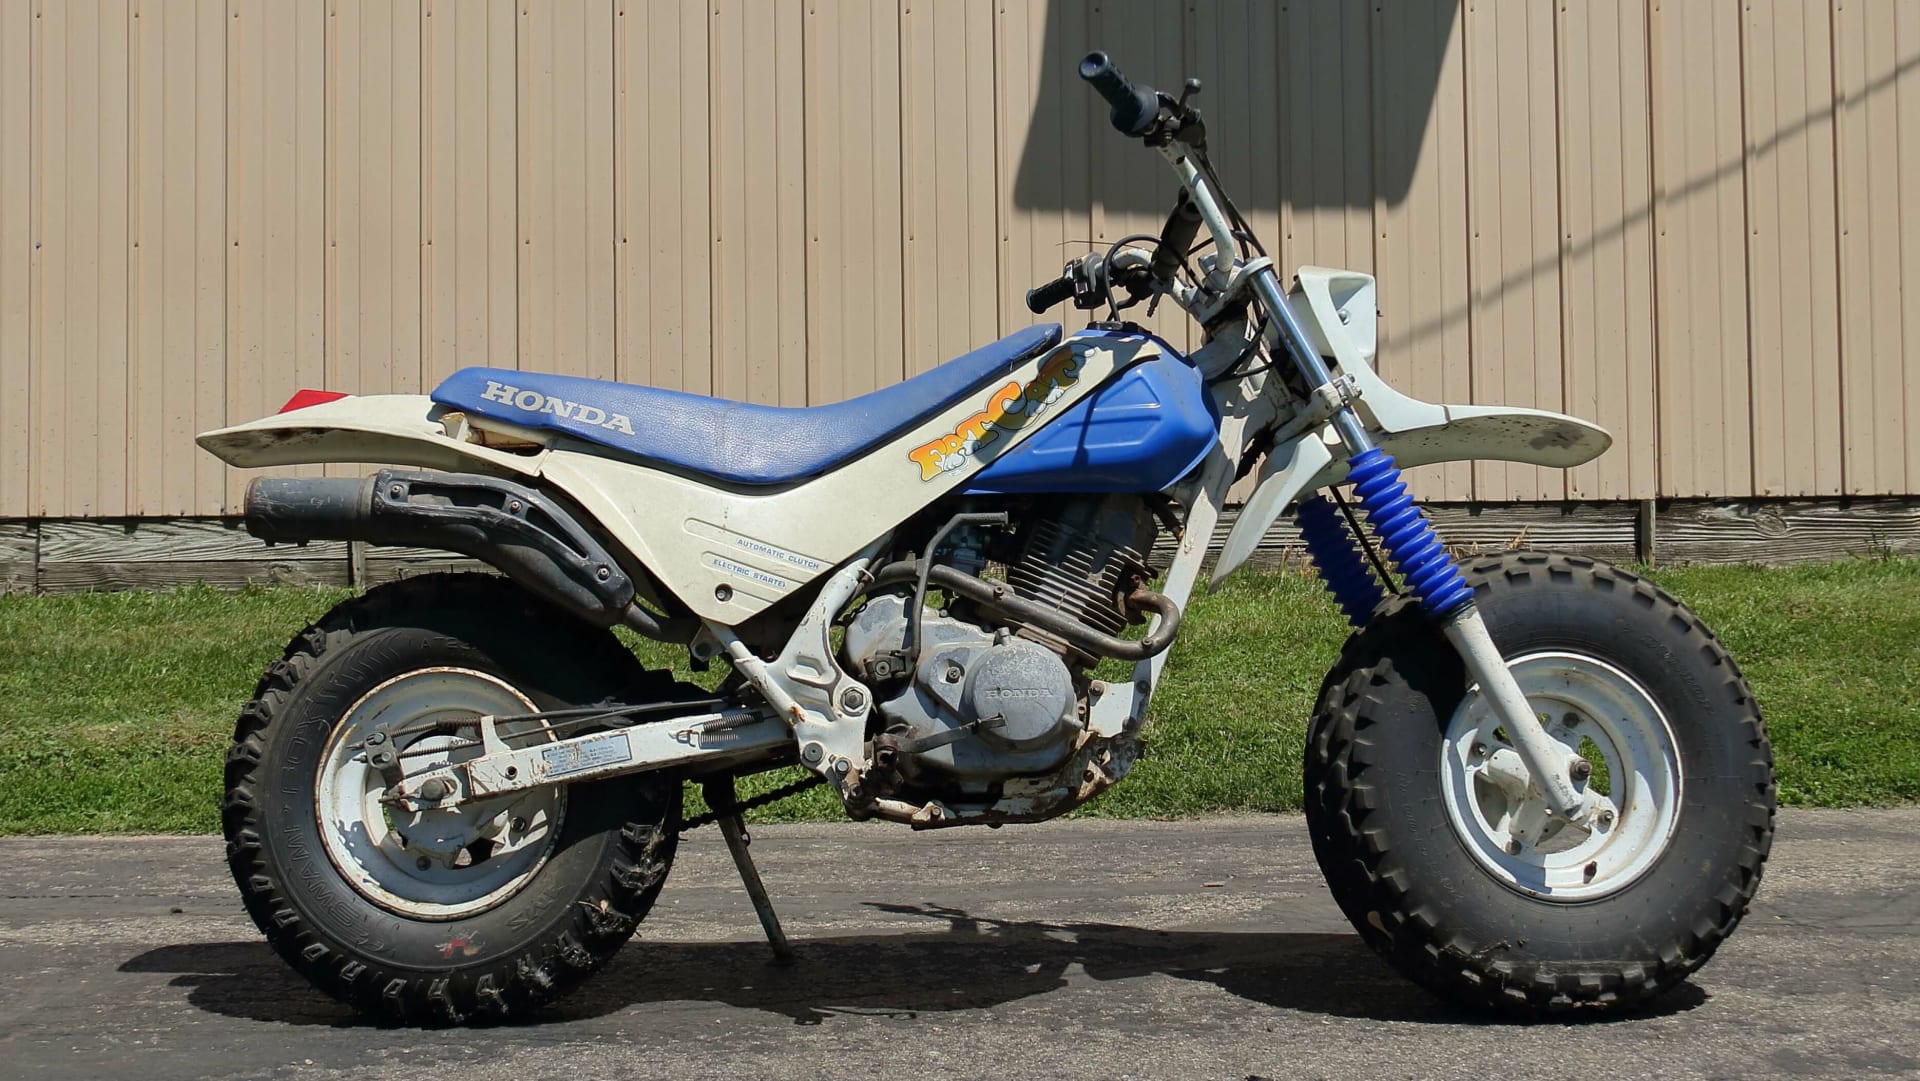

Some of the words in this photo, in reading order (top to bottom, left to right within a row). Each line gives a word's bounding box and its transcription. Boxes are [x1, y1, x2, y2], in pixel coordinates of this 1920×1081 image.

[480, 381, 636, 436] HONDA
[737, 539, 785, 560] AUTOMATIC
[788, 555, 820, 570] CLUTCH
[713, 560, 750, 576] ELECTRIC
[985, 688, 1054, 699] HONDA
